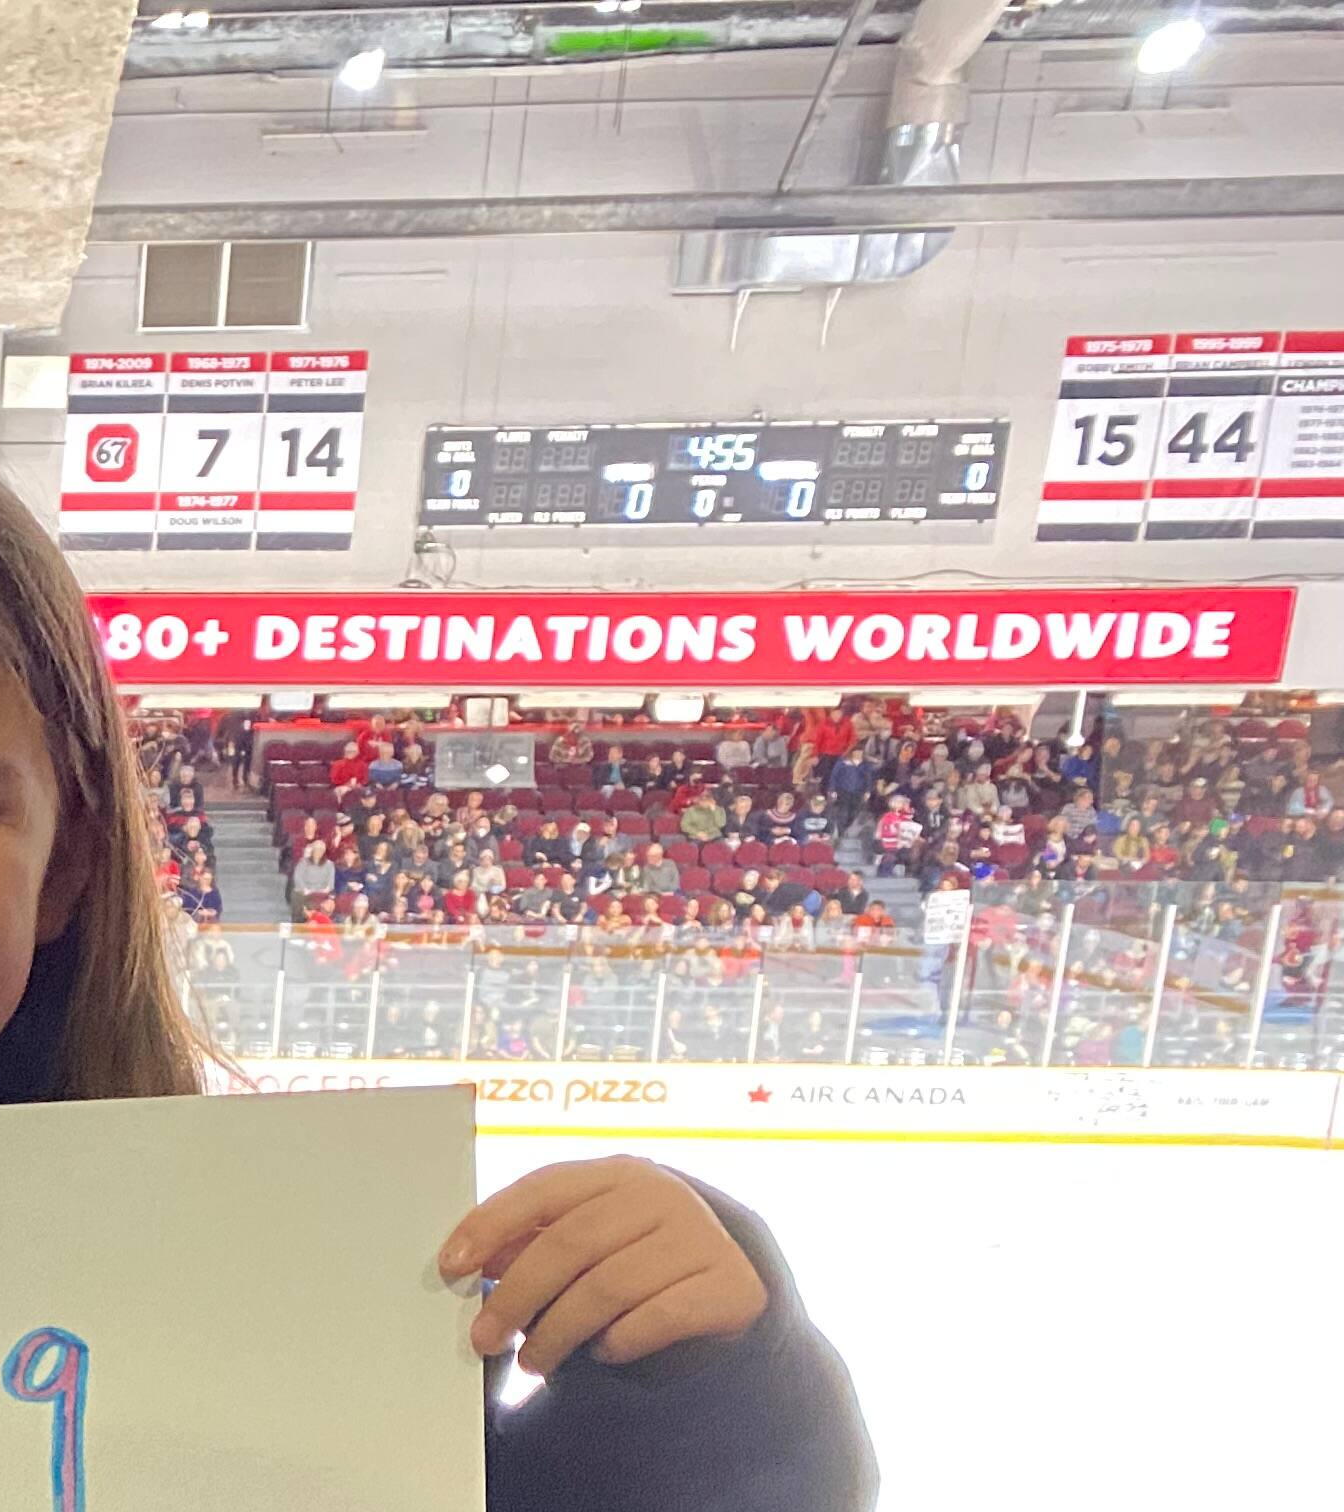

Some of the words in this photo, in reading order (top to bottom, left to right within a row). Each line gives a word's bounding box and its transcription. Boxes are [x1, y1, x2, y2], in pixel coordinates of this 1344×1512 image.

[180, 378, 212, 388] DENIS
[214, 378, 255, 388] POTVIN
[289, 377, 323, 388] PETER
[325, 377, 345, 387] LEE
[196, 428, 232, 478] 7
[280, 426, 345, 478] 14
[1074, 413, 1140, 467] 15
[1168, 410, 1257, 464] 44
[625, 483, 654, 520] 0
[787, 481, 817, 518] 0
[96, 612, 230, 662] 80+
[254, 612, 758, 663] DESTINATIONS
[783, 609, 1237, 662] WORLDWIDE
[460, 1078, 555, 1103] izza
[564, 1079, 669, 1112] pizza
[790, 1085, 835, 1104] AIR
[842, 1085, 967, 1105] CANADA
